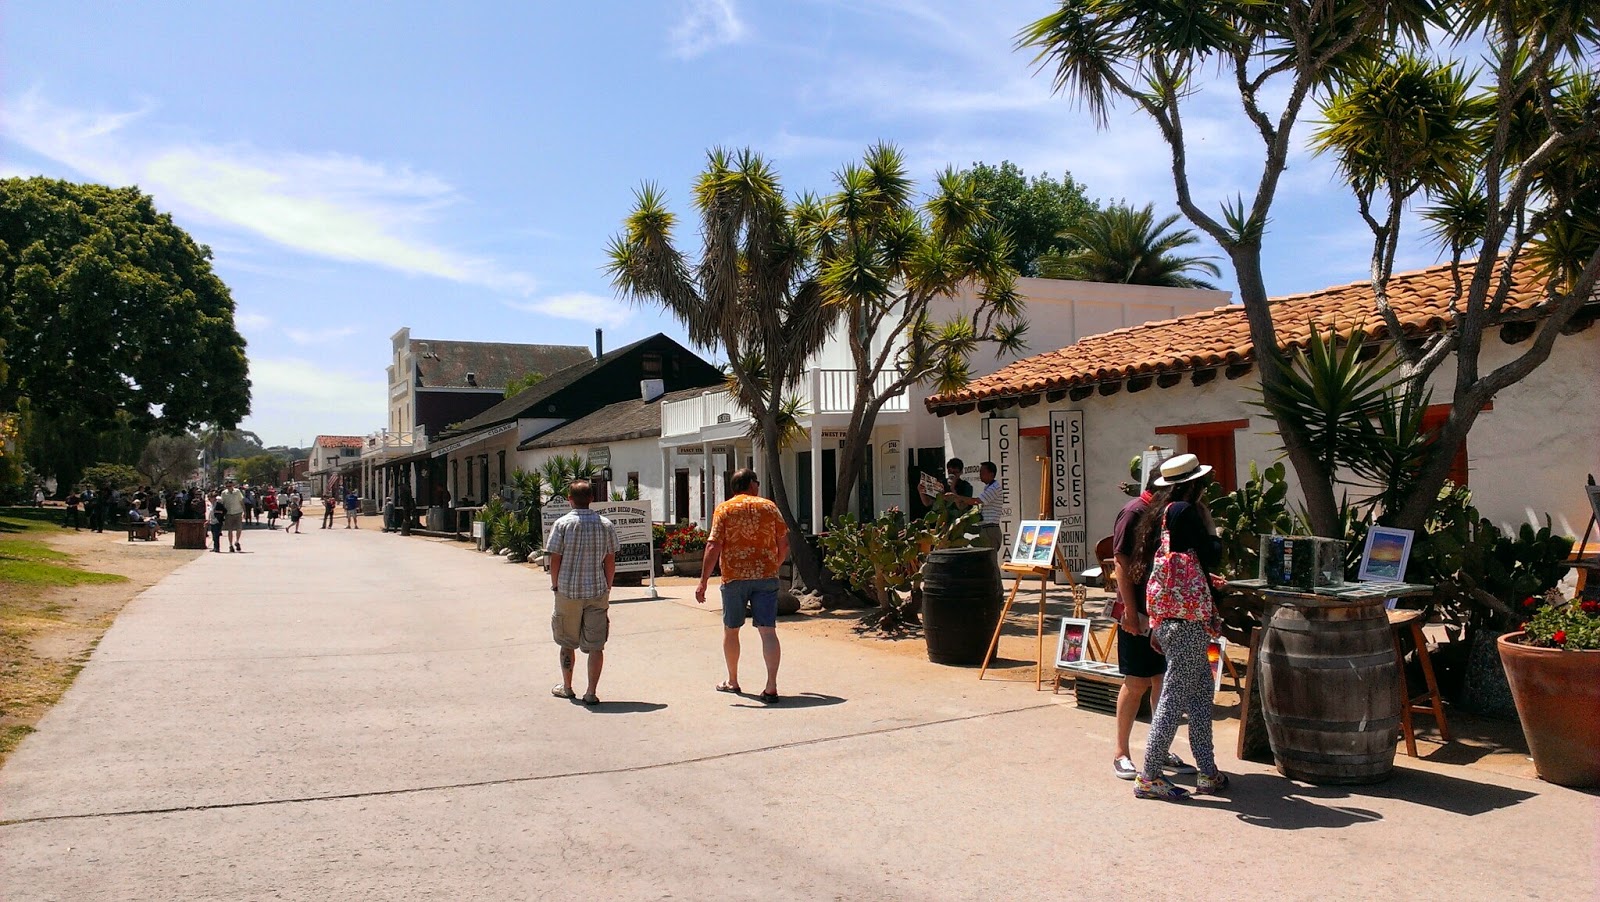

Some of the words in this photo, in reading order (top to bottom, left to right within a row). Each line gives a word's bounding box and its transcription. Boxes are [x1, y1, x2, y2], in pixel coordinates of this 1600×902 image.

[487, 423, 512, 436] CIGARS
[1054, 420, 1066, 492] HERBS
[1070, 419, 1081, 507] SPICES
[998, 424, 1010, 504] COFFEE
[1055, 496, 1068, 508] &
[1056, 530, 1085, 544] AROUND
[1062, 545, 1079, 557] THE
